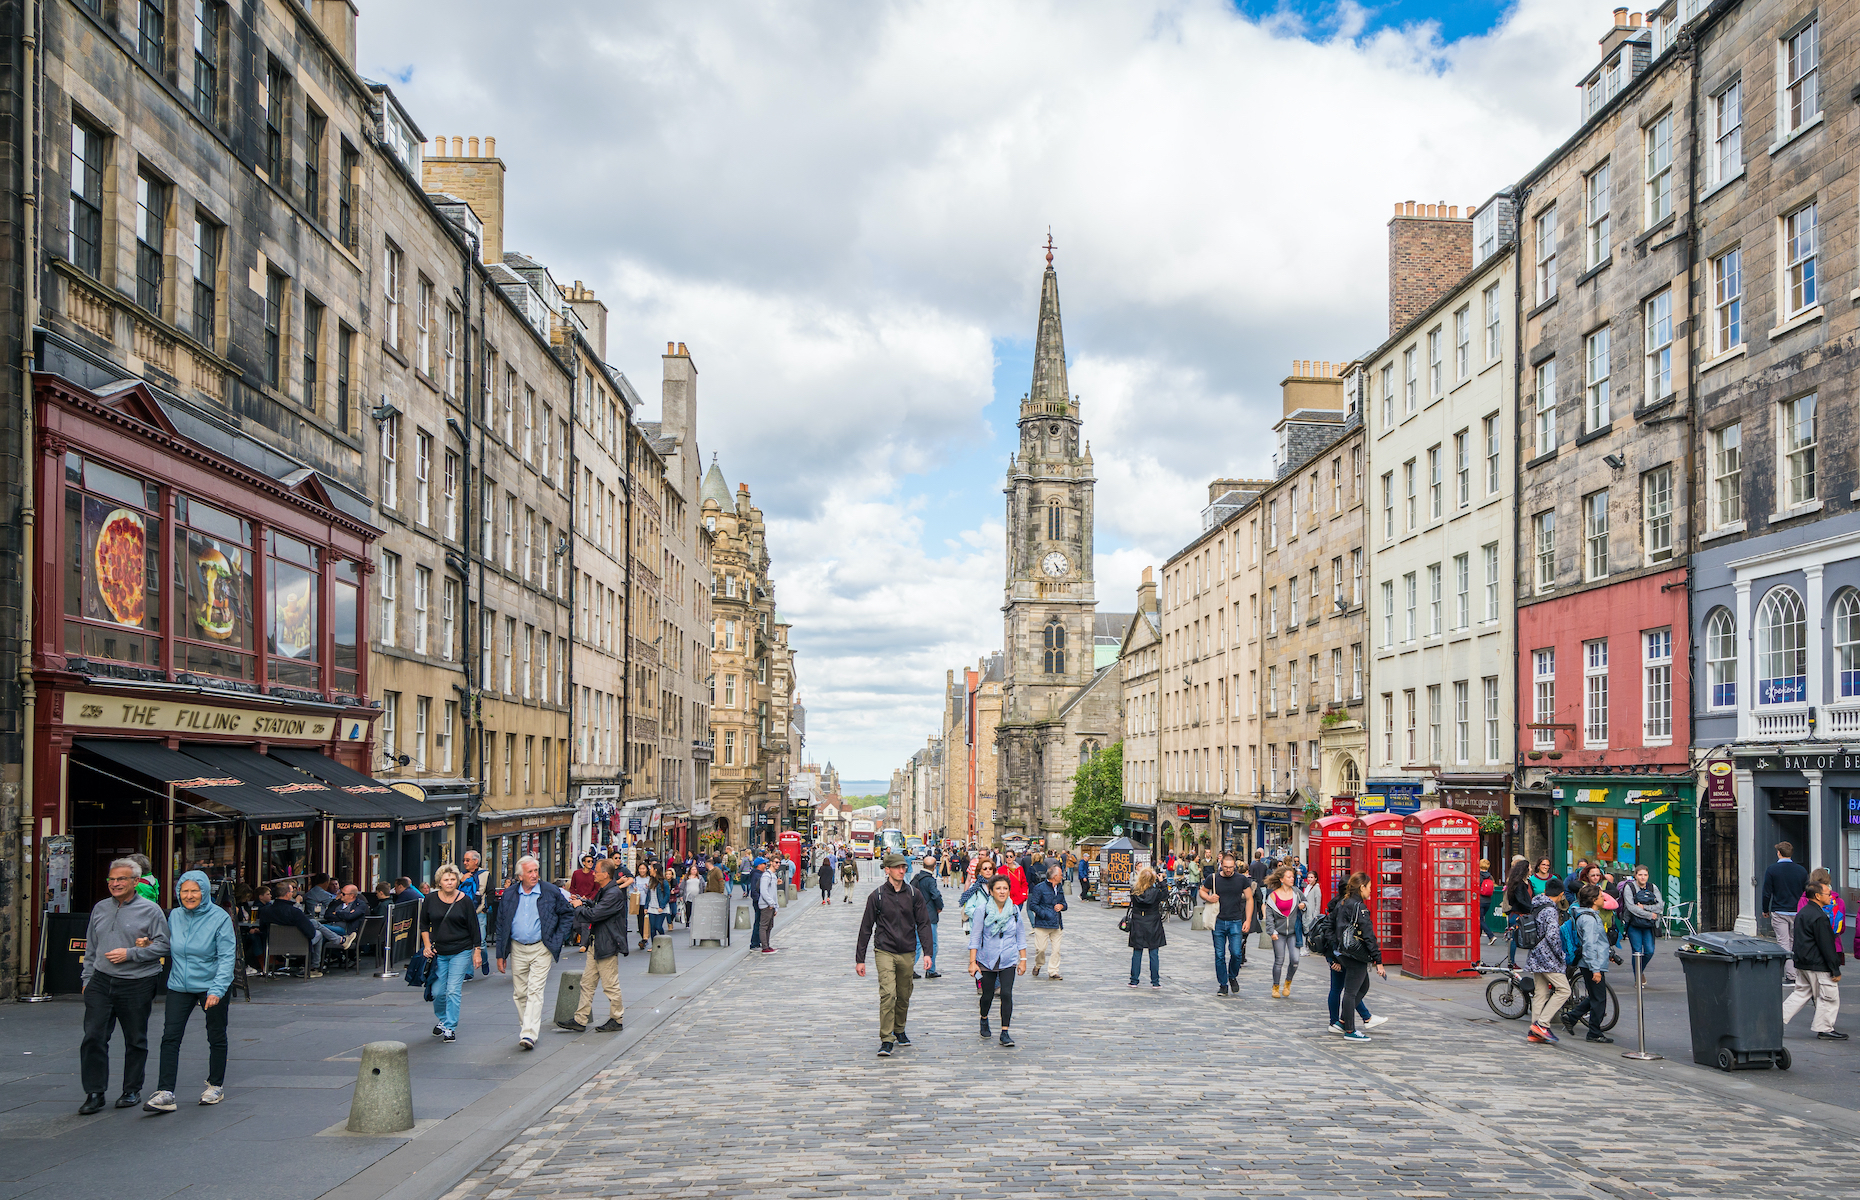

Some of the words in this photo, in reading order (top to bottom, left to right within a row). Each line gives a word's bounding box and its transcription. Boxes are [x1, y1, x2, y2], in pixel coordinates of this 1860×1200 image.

[80, 703, 103, 718] 235
[122, 703, 161, 726] THE
[175, 709, 241, 731] FILLING
[253, 716, 306, 735] STATION
[1785, 756, 1808, 769] BAY
[1817, 755, 1834, 769] OF
[1575, 788, 1609, 803] SUBWAY
[1642, 802, 1670, 823] SUBWAY
[260, 823, 281, 831] FILLING
[282, 821, 304, 829] STATION
[1111, 852, 1130, 863] FREE
[1108, 861, 1133, 872] GHOST
[1109, 872, 1130, 882] TOUR
[1667, 824, 1681, 925] SUBWAY
